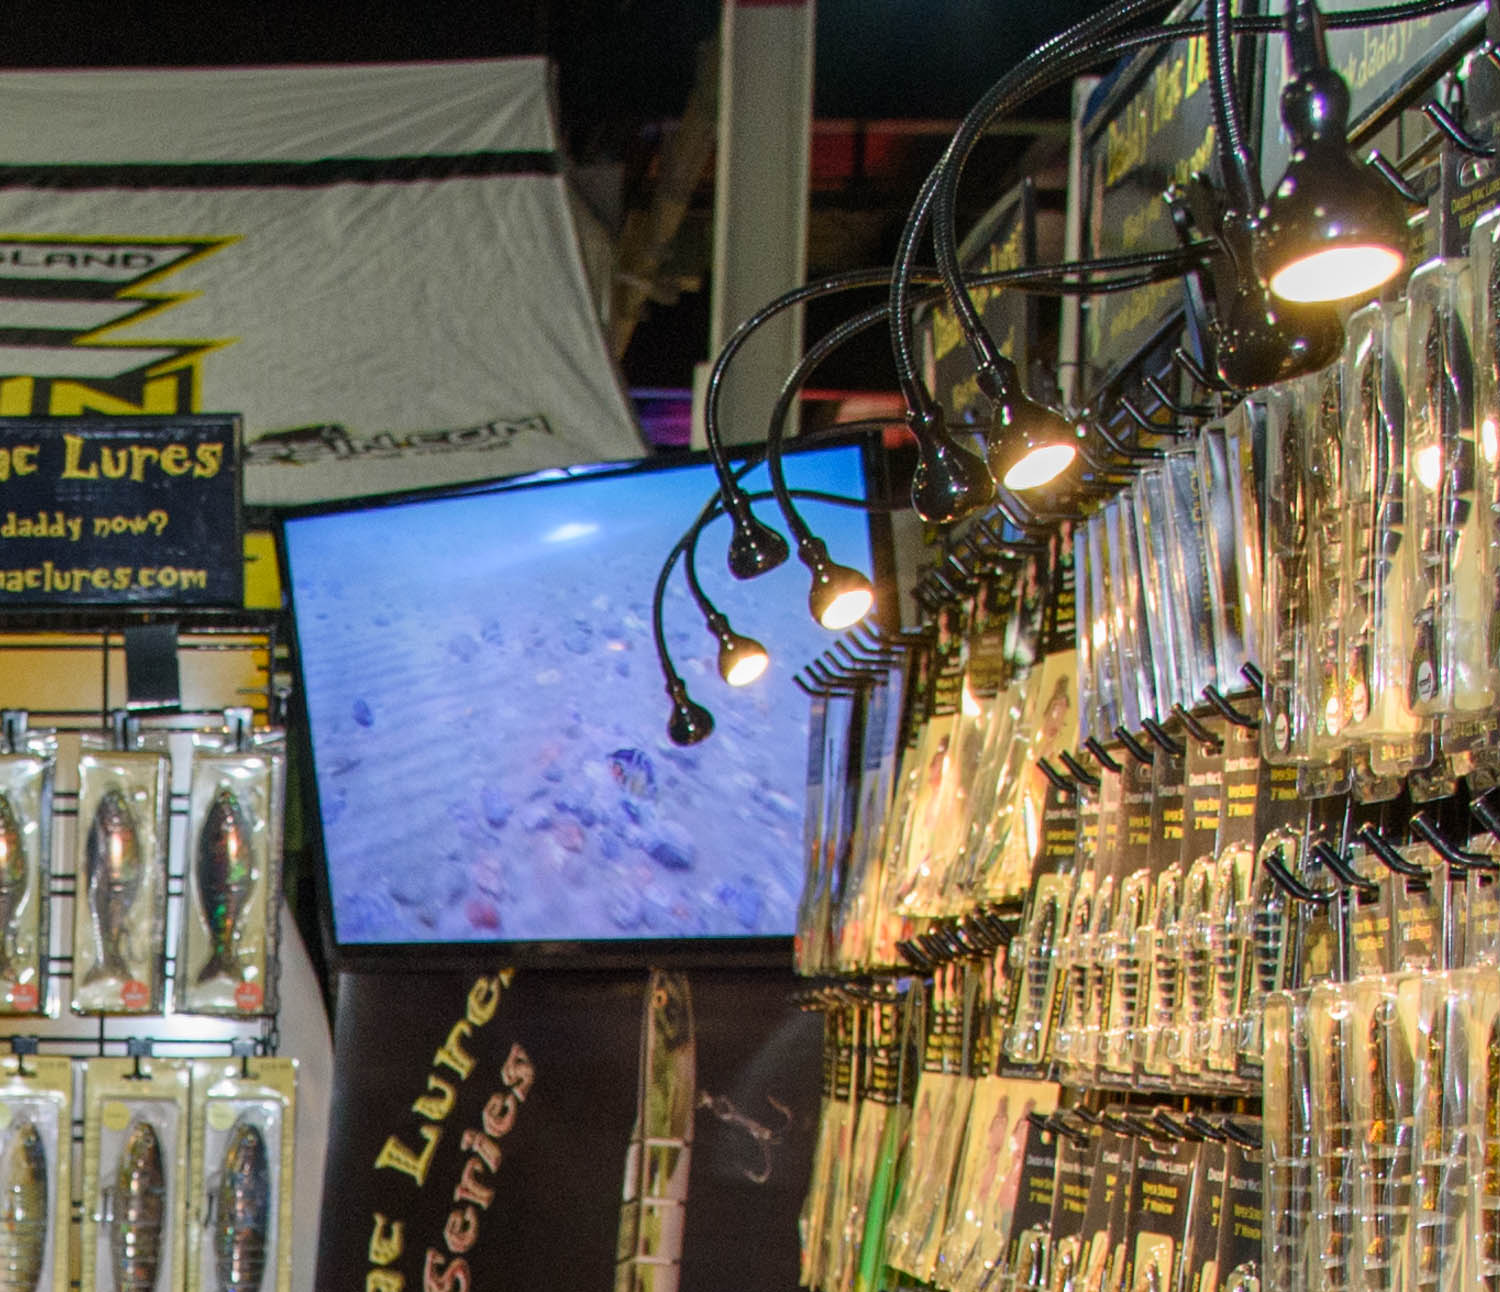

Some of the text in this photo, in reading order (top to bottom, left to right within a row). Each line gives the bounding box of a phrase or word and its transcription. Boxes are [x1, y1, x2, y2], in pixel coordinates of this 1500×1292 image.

[61, 433, 224, 480] Lures
[0, 511, 82, 542] daddy
[93, 511, 170, 539] now?
